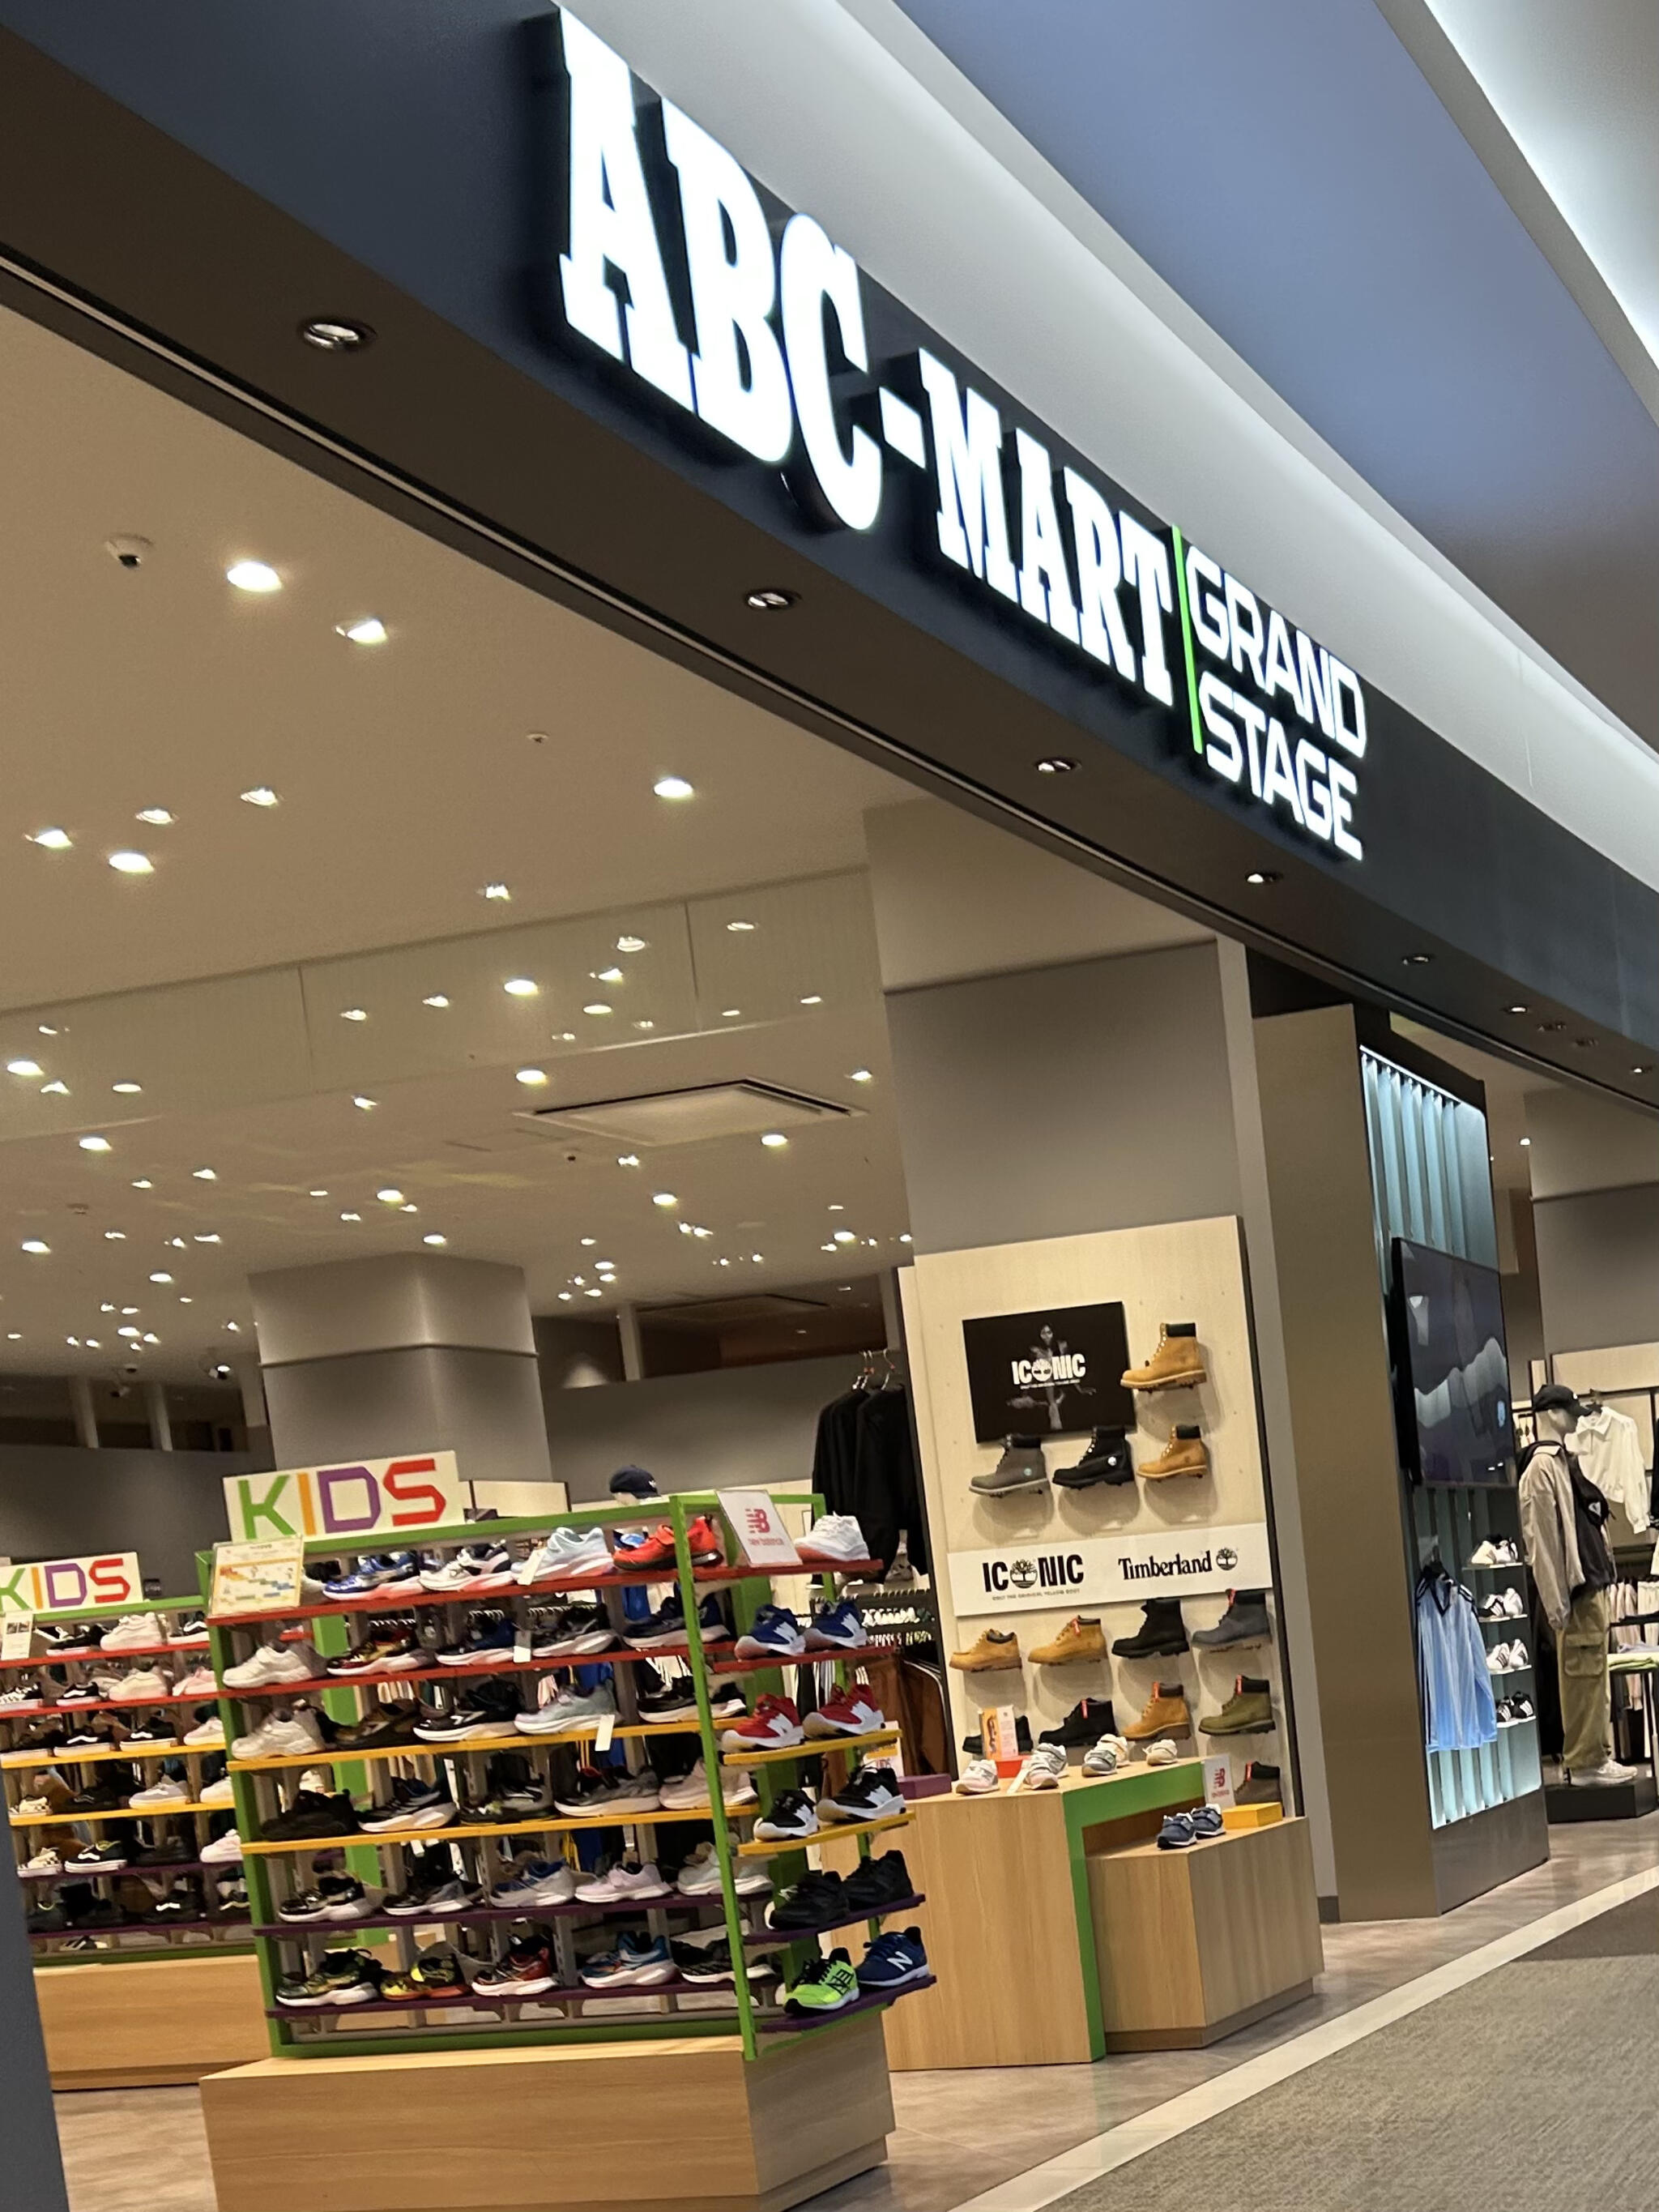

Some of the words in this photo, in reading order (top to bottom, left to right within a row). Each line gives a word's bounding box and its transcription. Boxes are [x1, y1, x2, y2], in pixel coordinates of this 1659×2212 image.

[558, 5, 1175, 707] ABC-MART
[1185, 544, 1368, 759] GRAND
[1196, 670, 1363, 861] STAGE
[237, 1458, 447, 1539] KIDS
[1117, 1549, 1213, 1581] Timberland
